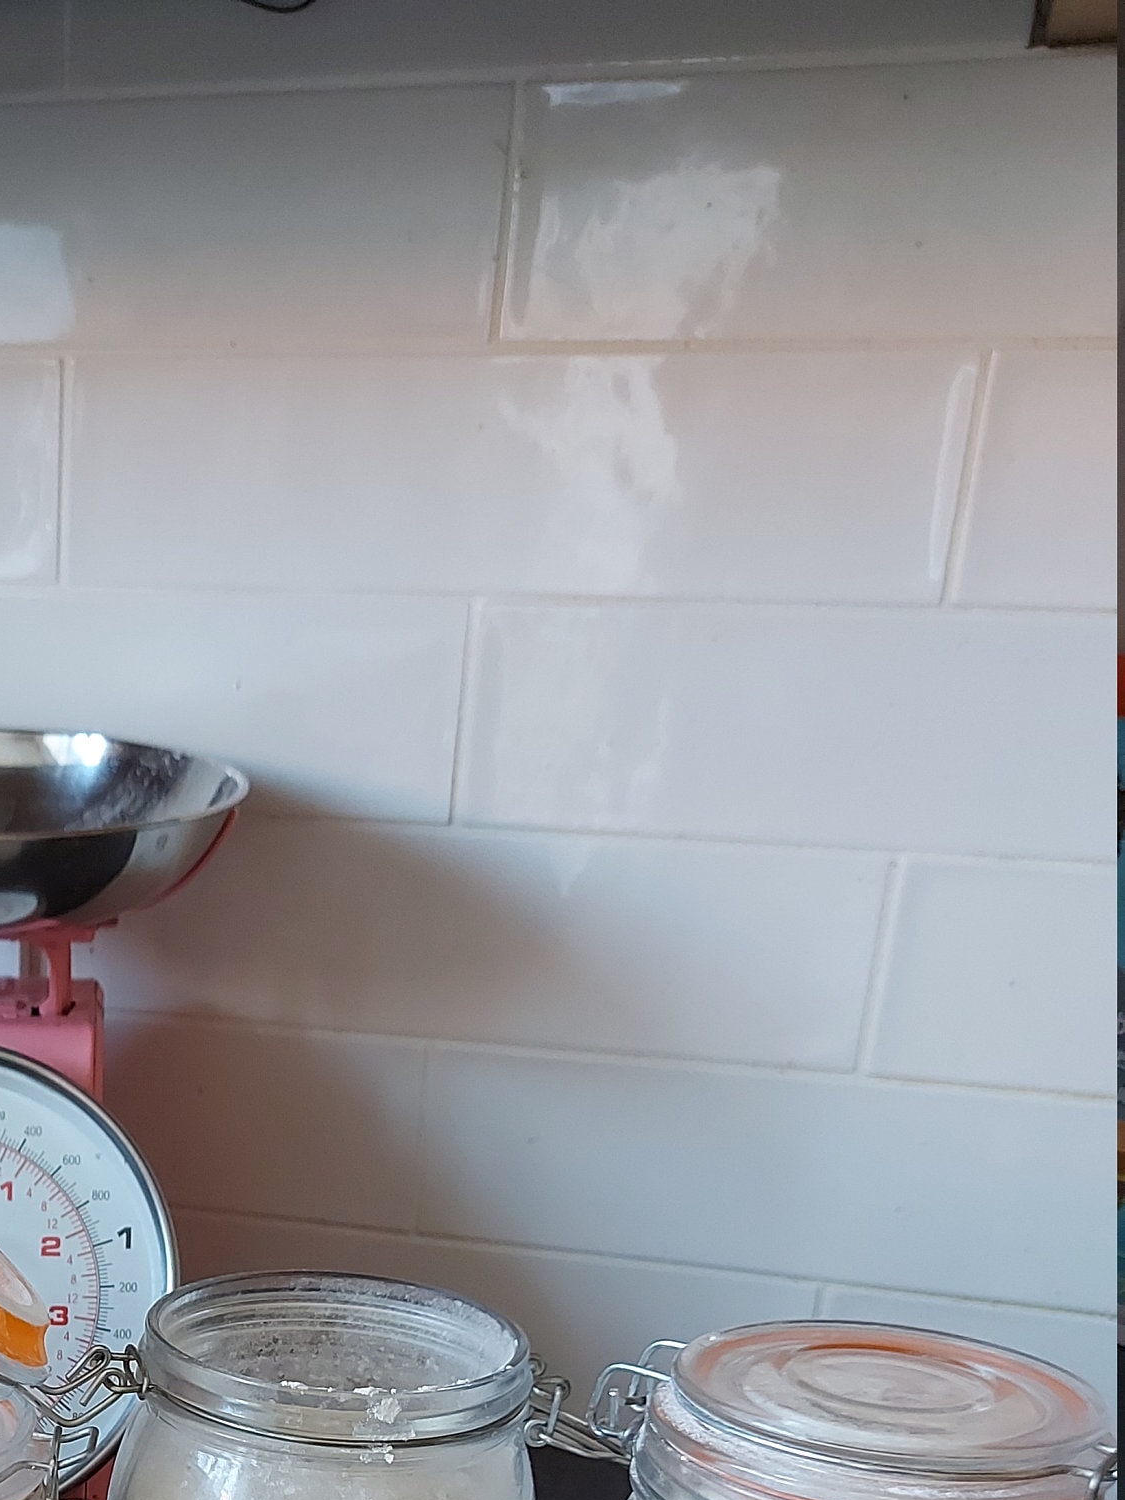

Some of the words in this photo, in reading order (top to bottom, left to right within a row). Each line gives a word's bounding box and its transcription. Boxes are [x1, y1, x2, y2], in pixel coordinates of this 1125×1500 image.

[24, 1126, 42, 1136] 400
[62, 1154, 81, 1165] 600
[0, 1181, 13, 1201] 1
[26, 1187, 32, 1198] 4
[91, 1190, 110, 1201] 800
[47, 1218, 58, 1229] 12
[117, 1226, 132, 1249] 1
[41, 1236, 61, 1257] 2
[66, 1254, 73, 1265] 4
[119, 1282, 138, 1293] 200
[67, 1293, 78, 1304] 12
[49, 1305, 68, 1326] 3
[64, 1331, 70, 1341] 4
[113, 1329, 131, 1340] 400
[57, 1350, 63, 1360] 8
